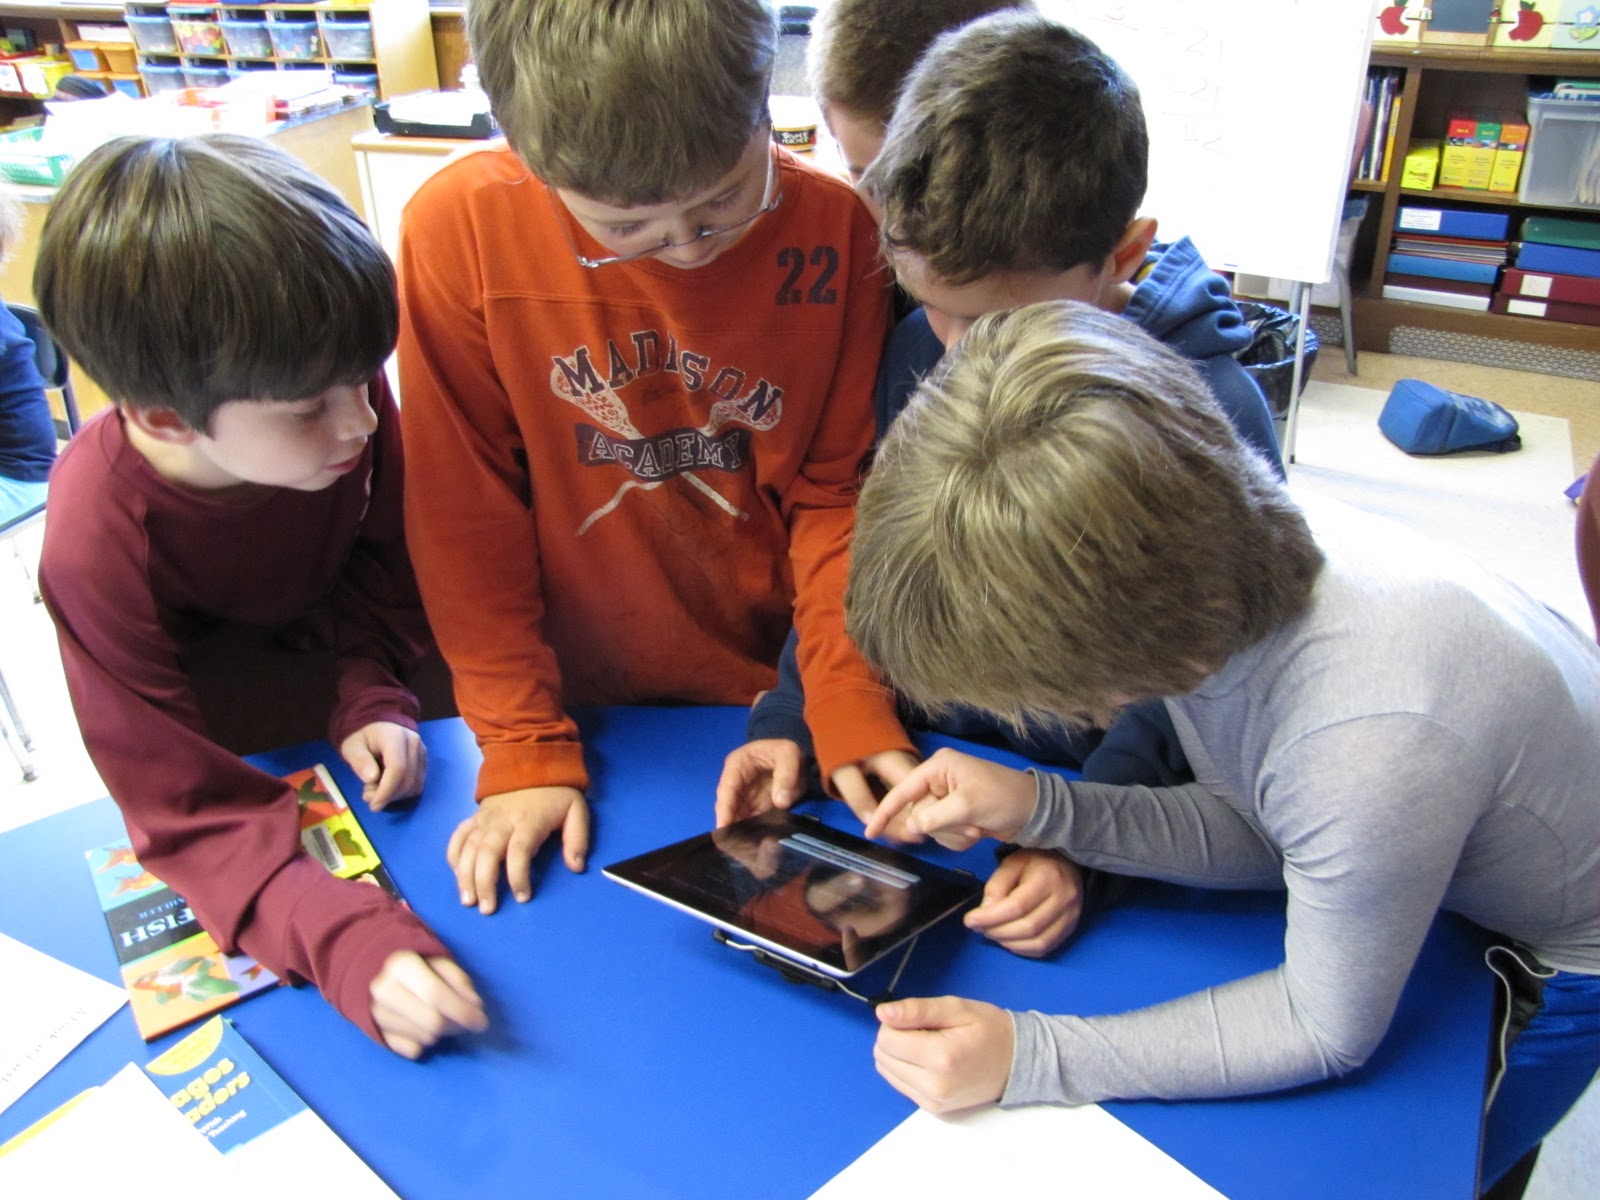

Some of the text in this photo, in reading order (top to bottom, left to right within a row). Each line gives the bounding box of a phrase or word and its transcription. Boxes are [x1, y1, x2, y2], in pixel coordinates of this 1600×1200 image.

[775, 245, 840, 306] 22
[552, 329, 785, 423] MADISON
[588, 431, 743, 478] ACADEMY
